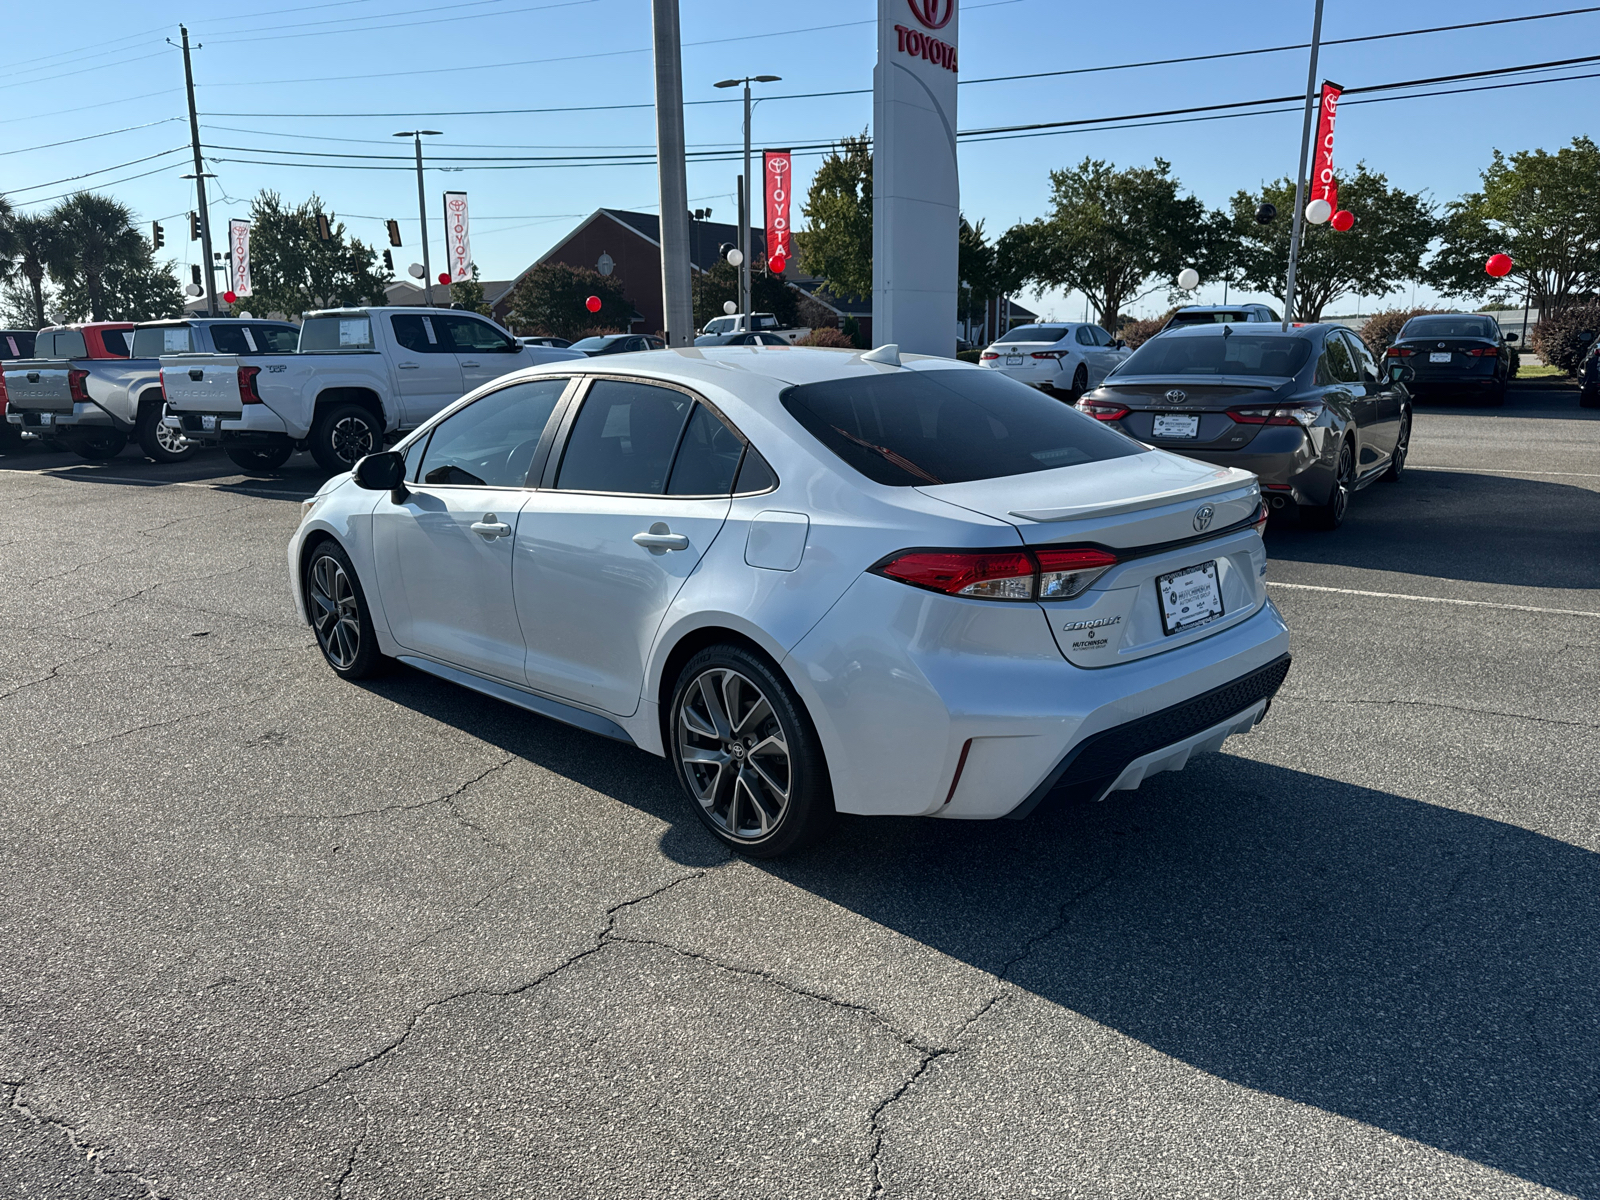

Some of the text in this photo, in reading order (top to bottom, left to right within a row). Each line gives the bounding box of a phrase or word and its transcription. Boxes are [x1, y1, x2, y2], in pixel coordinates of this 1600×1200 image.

[894, 24, 958, 73] TOYOTA
[1320, 116, 1336, 200] TOYOT
[773, 175, 786, 256] TOYOTA
[235, 237, 247, 292] TOYOTA
[454, 213, 467, 277] TOYOTA
[175, 389, 227, 398] TACOMA
[1063, 615, 1121, 631] COROLLA
[1072, 638, 1108, 648] HUTCHINSON
